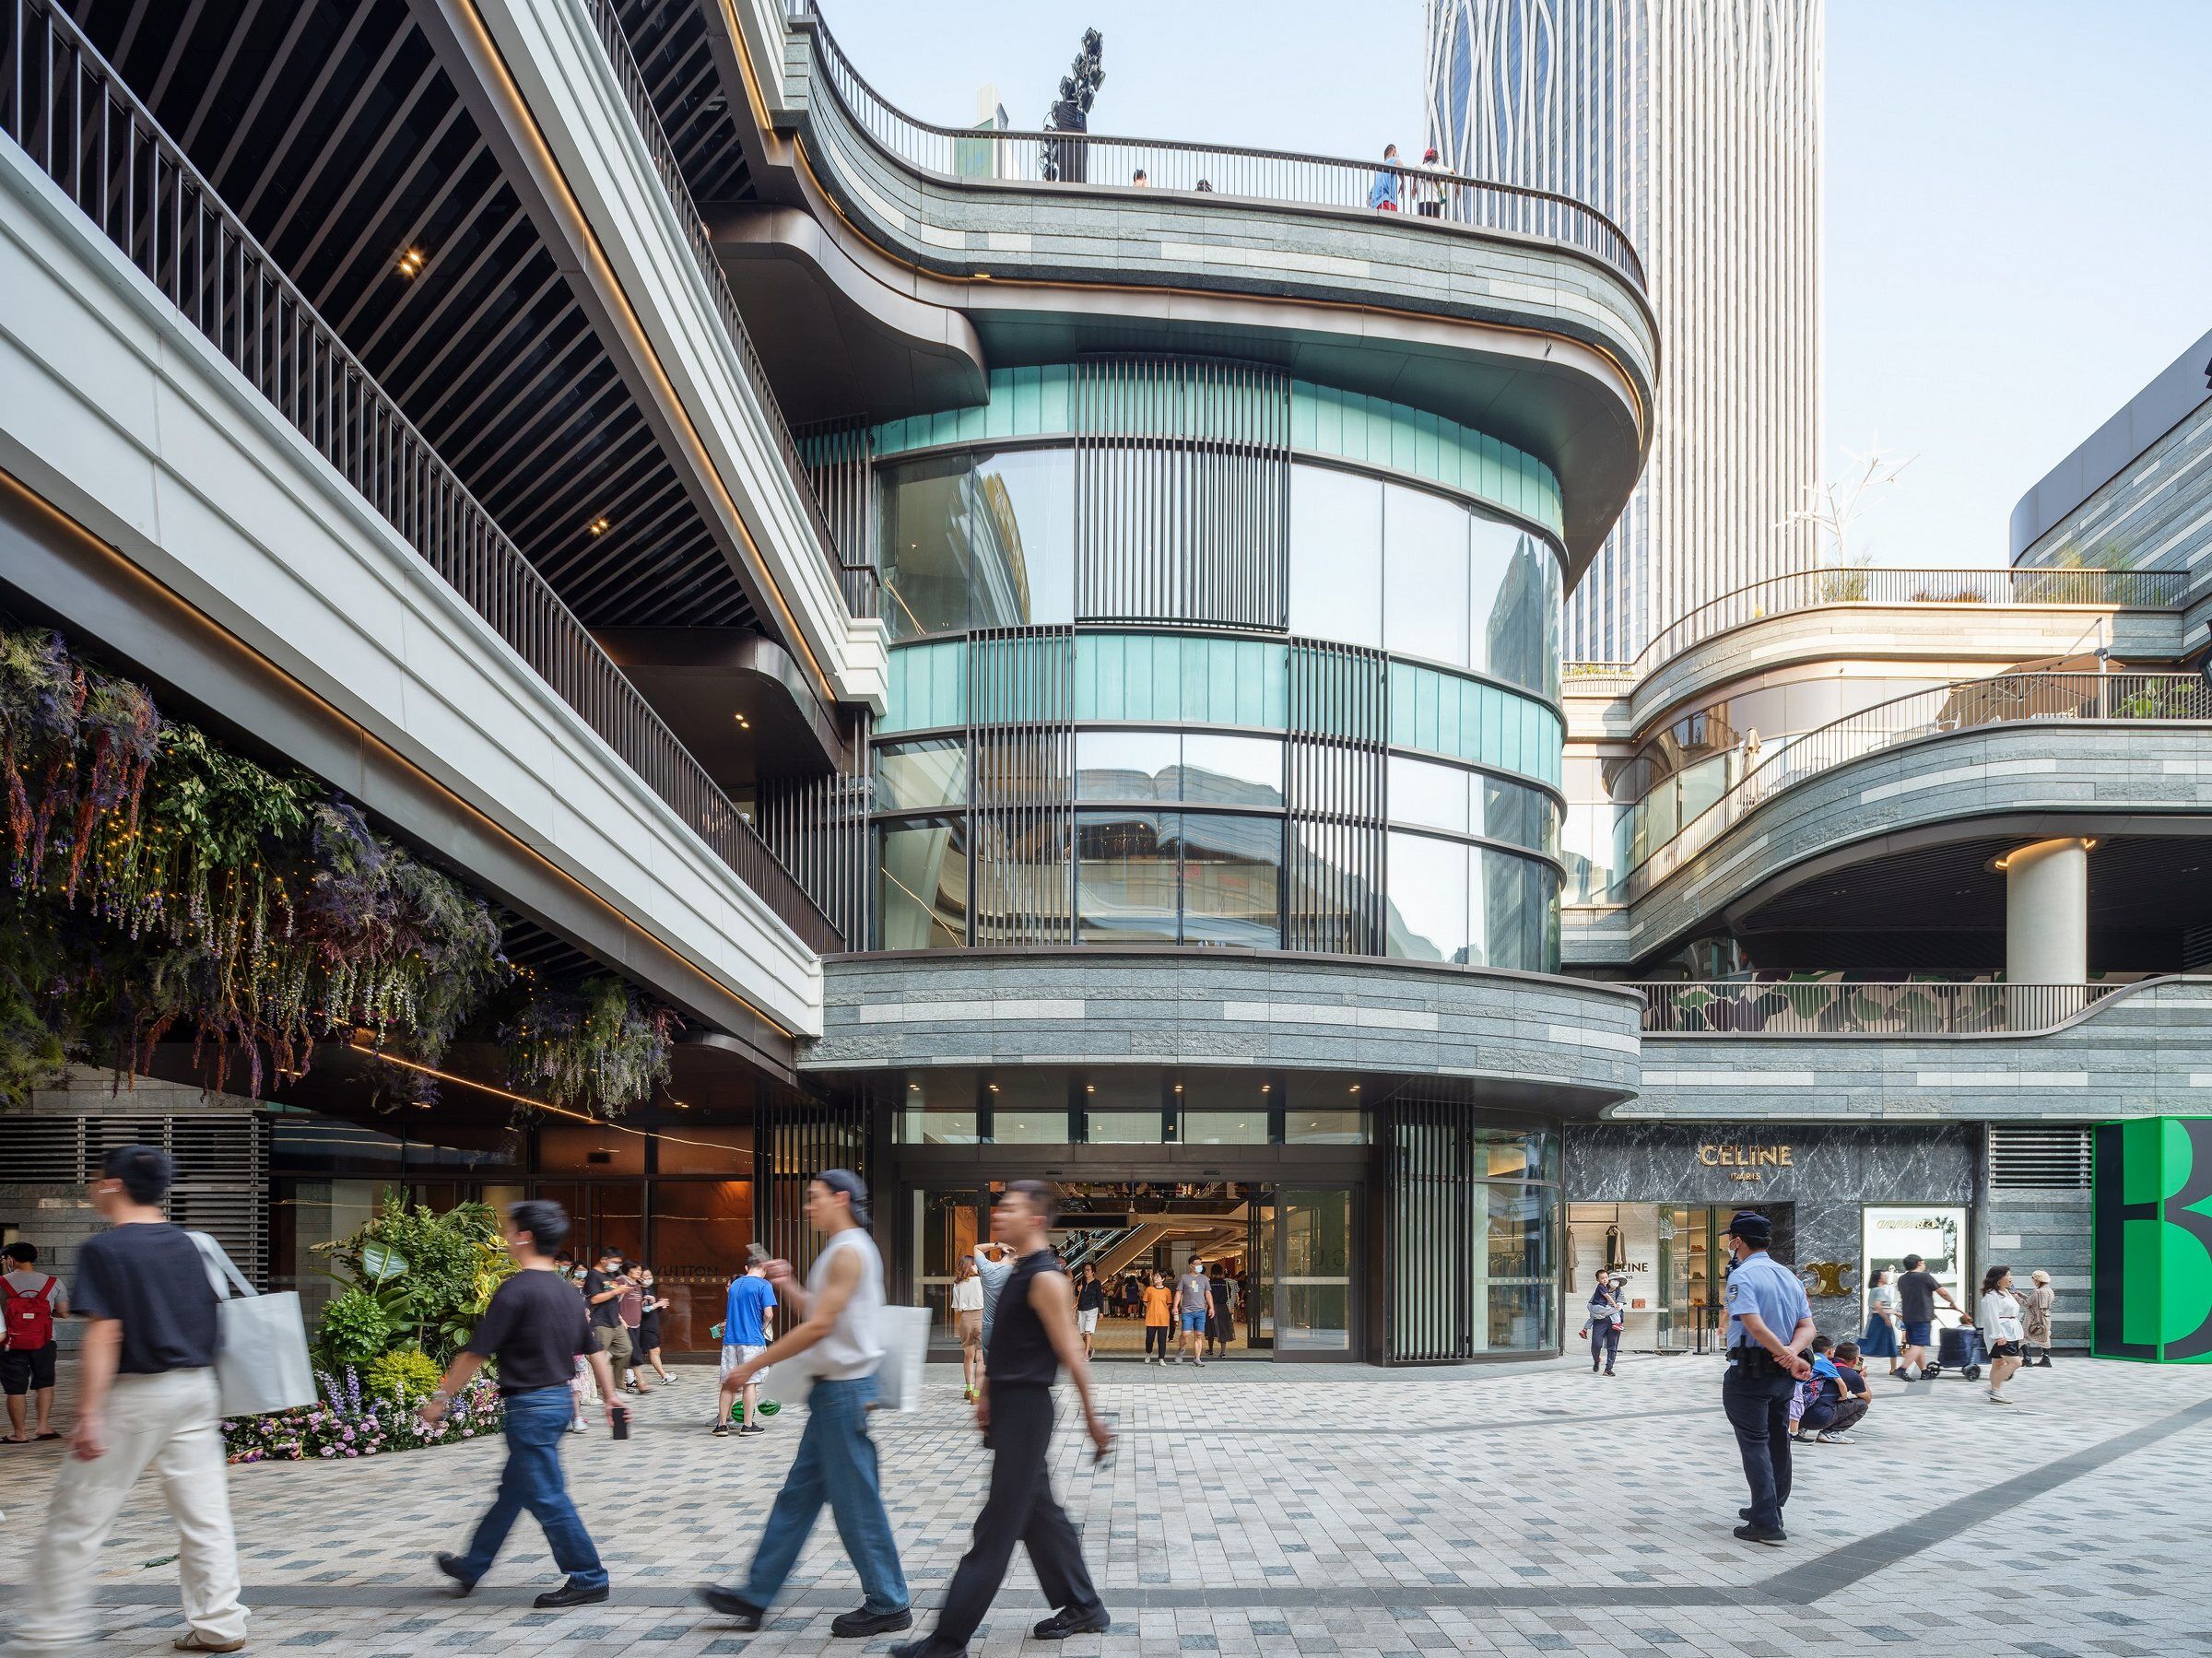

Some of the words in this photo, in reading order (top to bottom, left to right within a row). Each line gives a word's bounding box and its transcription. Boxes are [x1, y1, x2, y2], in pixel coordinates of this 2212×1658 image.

[1699, 1146, 1794, 1167] CELINE
[1730, 1172, 1761, 1182] PARIS
[1604, 1263, 1649, 1272] CELINE
